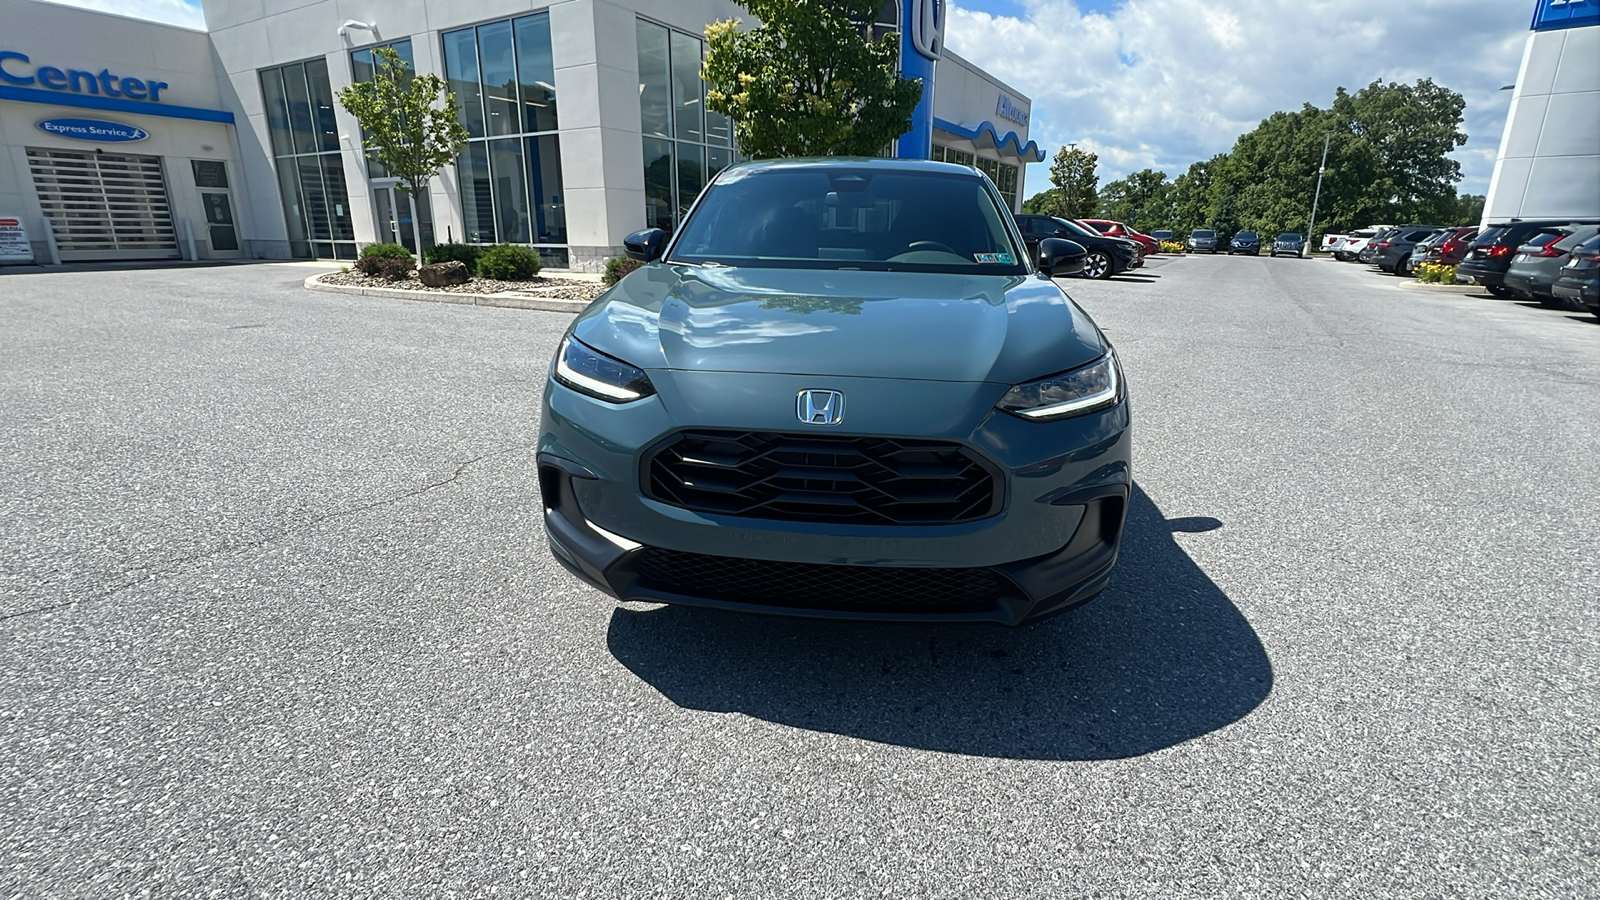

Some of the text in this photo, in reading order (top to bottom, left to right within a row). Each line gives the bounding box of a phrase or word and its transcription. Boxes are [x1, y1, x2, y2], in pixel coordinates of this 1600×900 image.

[0, 51, 168, 101] Center
[44, 122, 127, 136] Express Service
